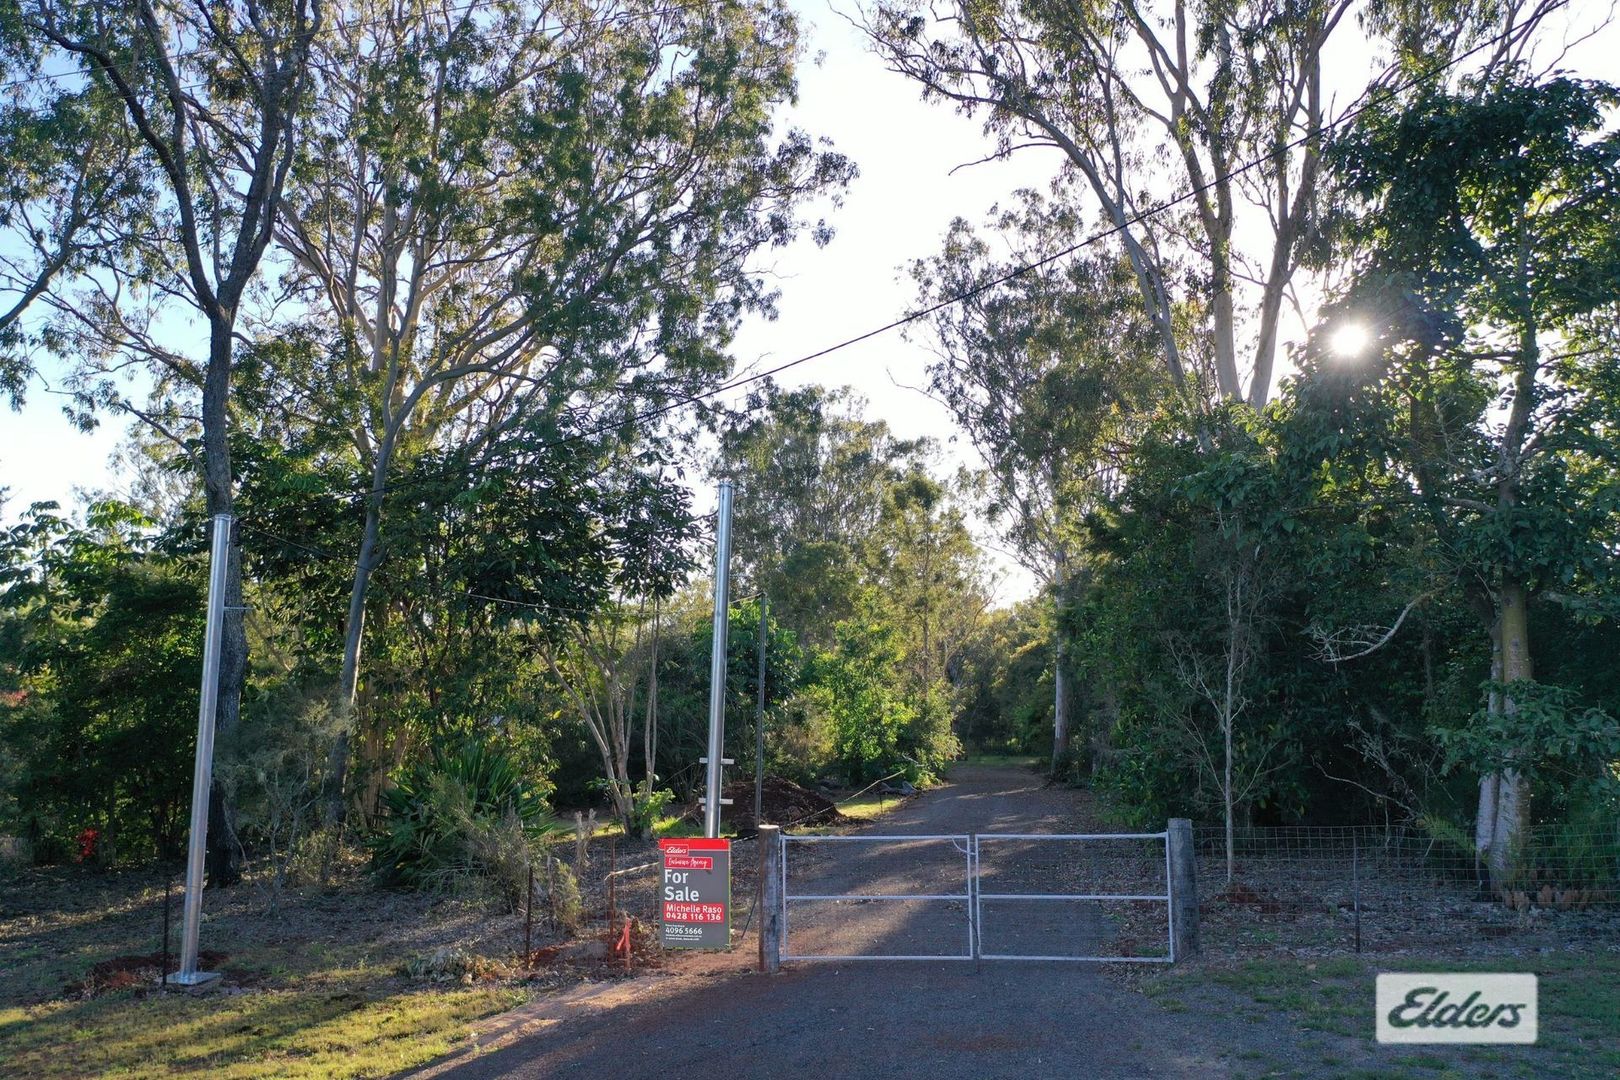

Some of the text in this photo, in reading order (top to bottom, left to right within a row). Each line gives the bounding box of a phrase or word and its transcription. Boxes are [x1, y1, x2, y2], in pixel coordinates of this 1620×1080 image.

[666, 846, 687, 854] Elders
[664, 869, 688, 884] For
[664, 886, 699, 902] Sale
[666, 903, 722, 913] Michelle Raso
[666, 912, 688, 920] 0428
[706, 913, 721, 921] 136
[684, 927, 703, 935] 5666
